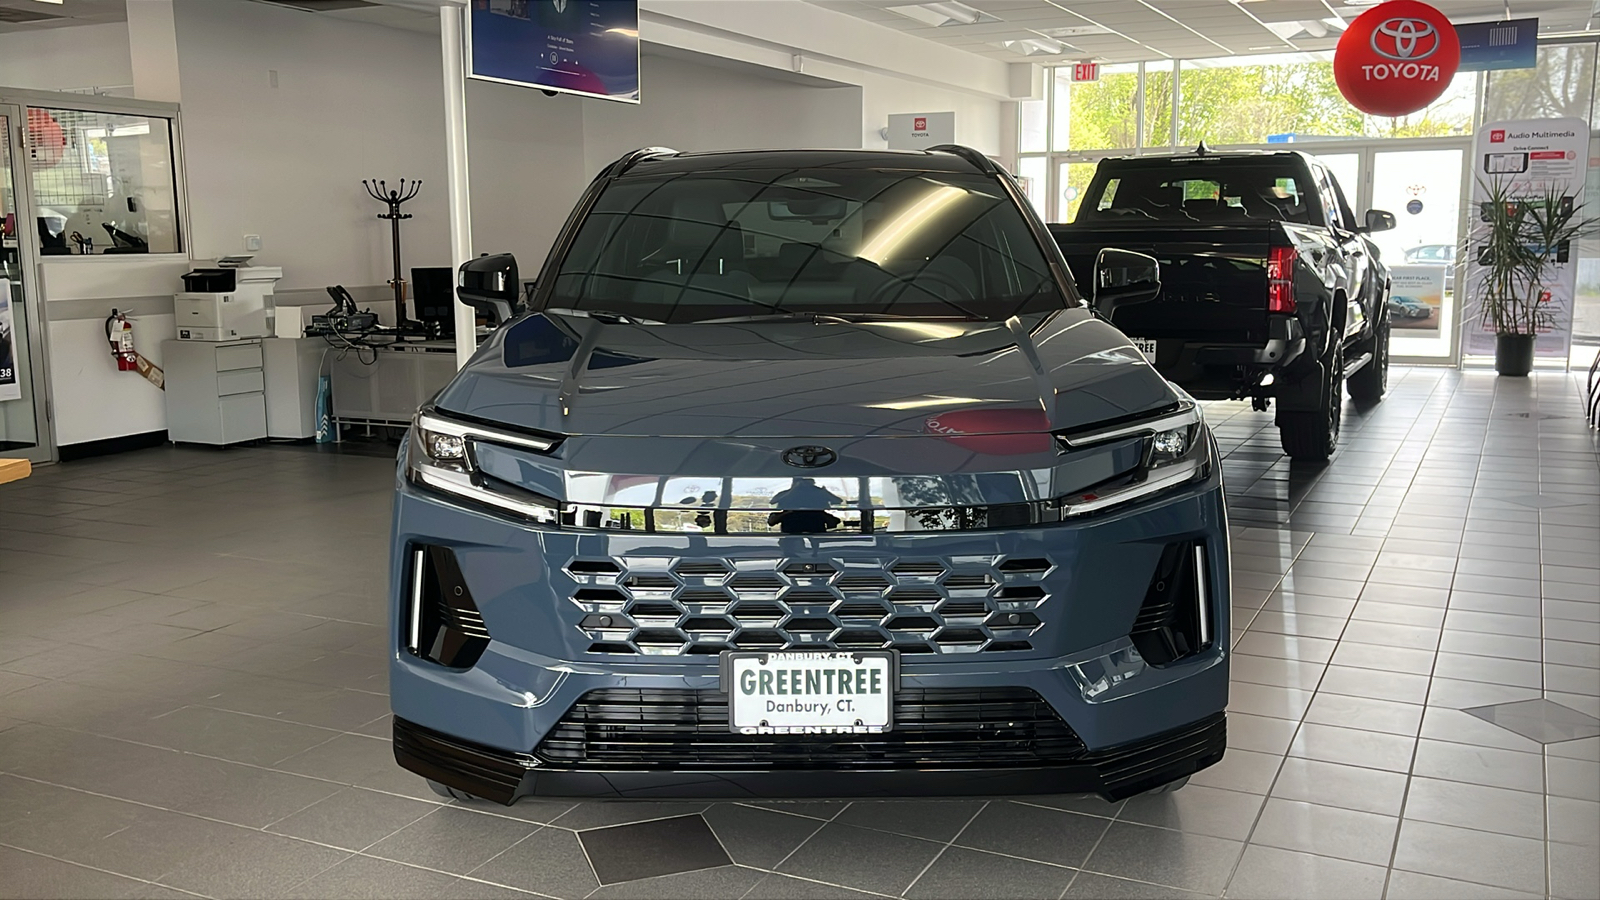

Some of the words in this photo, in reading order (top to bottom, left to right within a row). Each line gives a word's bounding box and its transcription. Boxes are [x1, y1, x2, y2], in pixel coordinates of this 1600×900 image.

[1076, 63, 1096, 80] EXIT
[1361, 63, 1440, 81] TOYOTA
[1531, 130, 1575, 138] Multimedia
[740, 668, 882, 695] GREENTREE
[766, 699, 832, 716] Danbury,
[836, 700, 855, 713] CT.
[740, 726, 883, 734] GREENTREE
